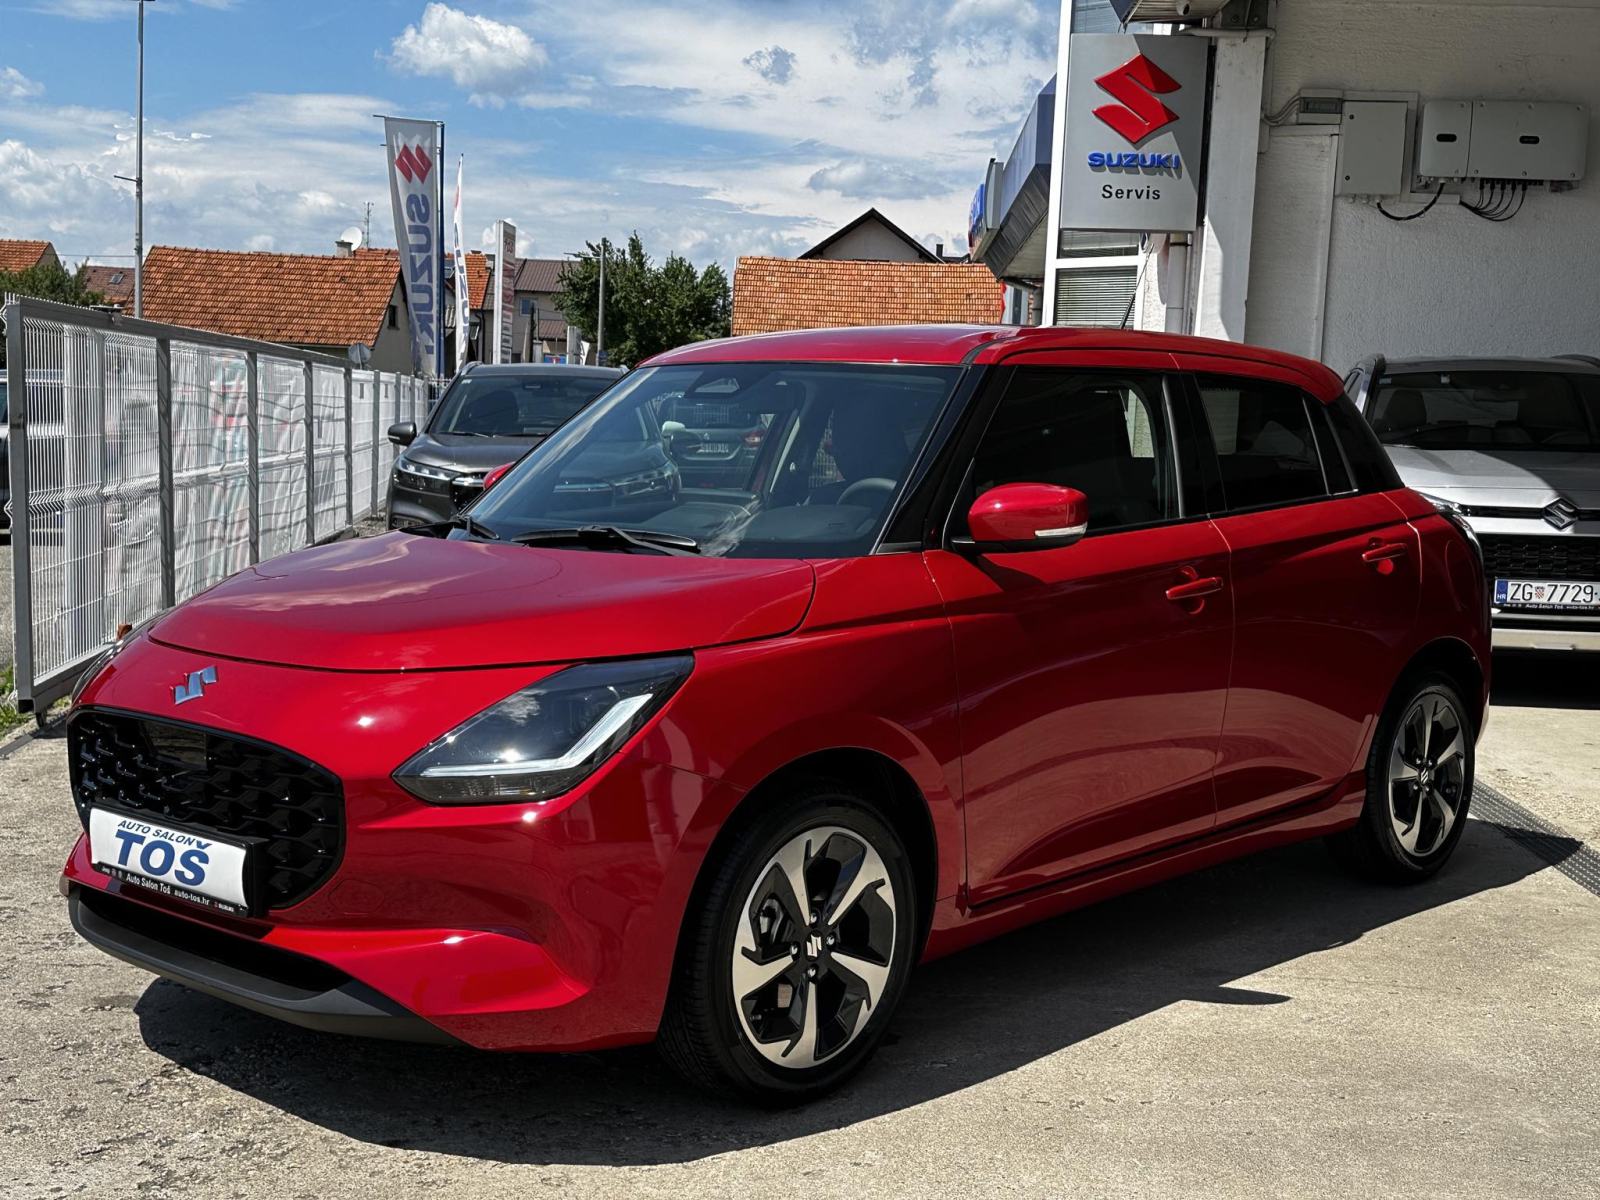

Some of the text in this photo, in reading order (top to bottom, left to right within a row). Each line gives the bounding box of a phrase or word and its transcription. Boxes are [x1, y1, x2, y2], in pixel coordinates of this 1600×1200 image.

[1087, 152, 1180, 169] SUZUKI
[1102, 184, 1160, 200] Servis
[1510, 583, 1533, 601] ZG
[118, 820, 196, 846] AUTO SALON
[115, 829, 213, 886] TOŠ
[126, 873, 140, 885] Auto
[141, 877, 158, 891] Salon
